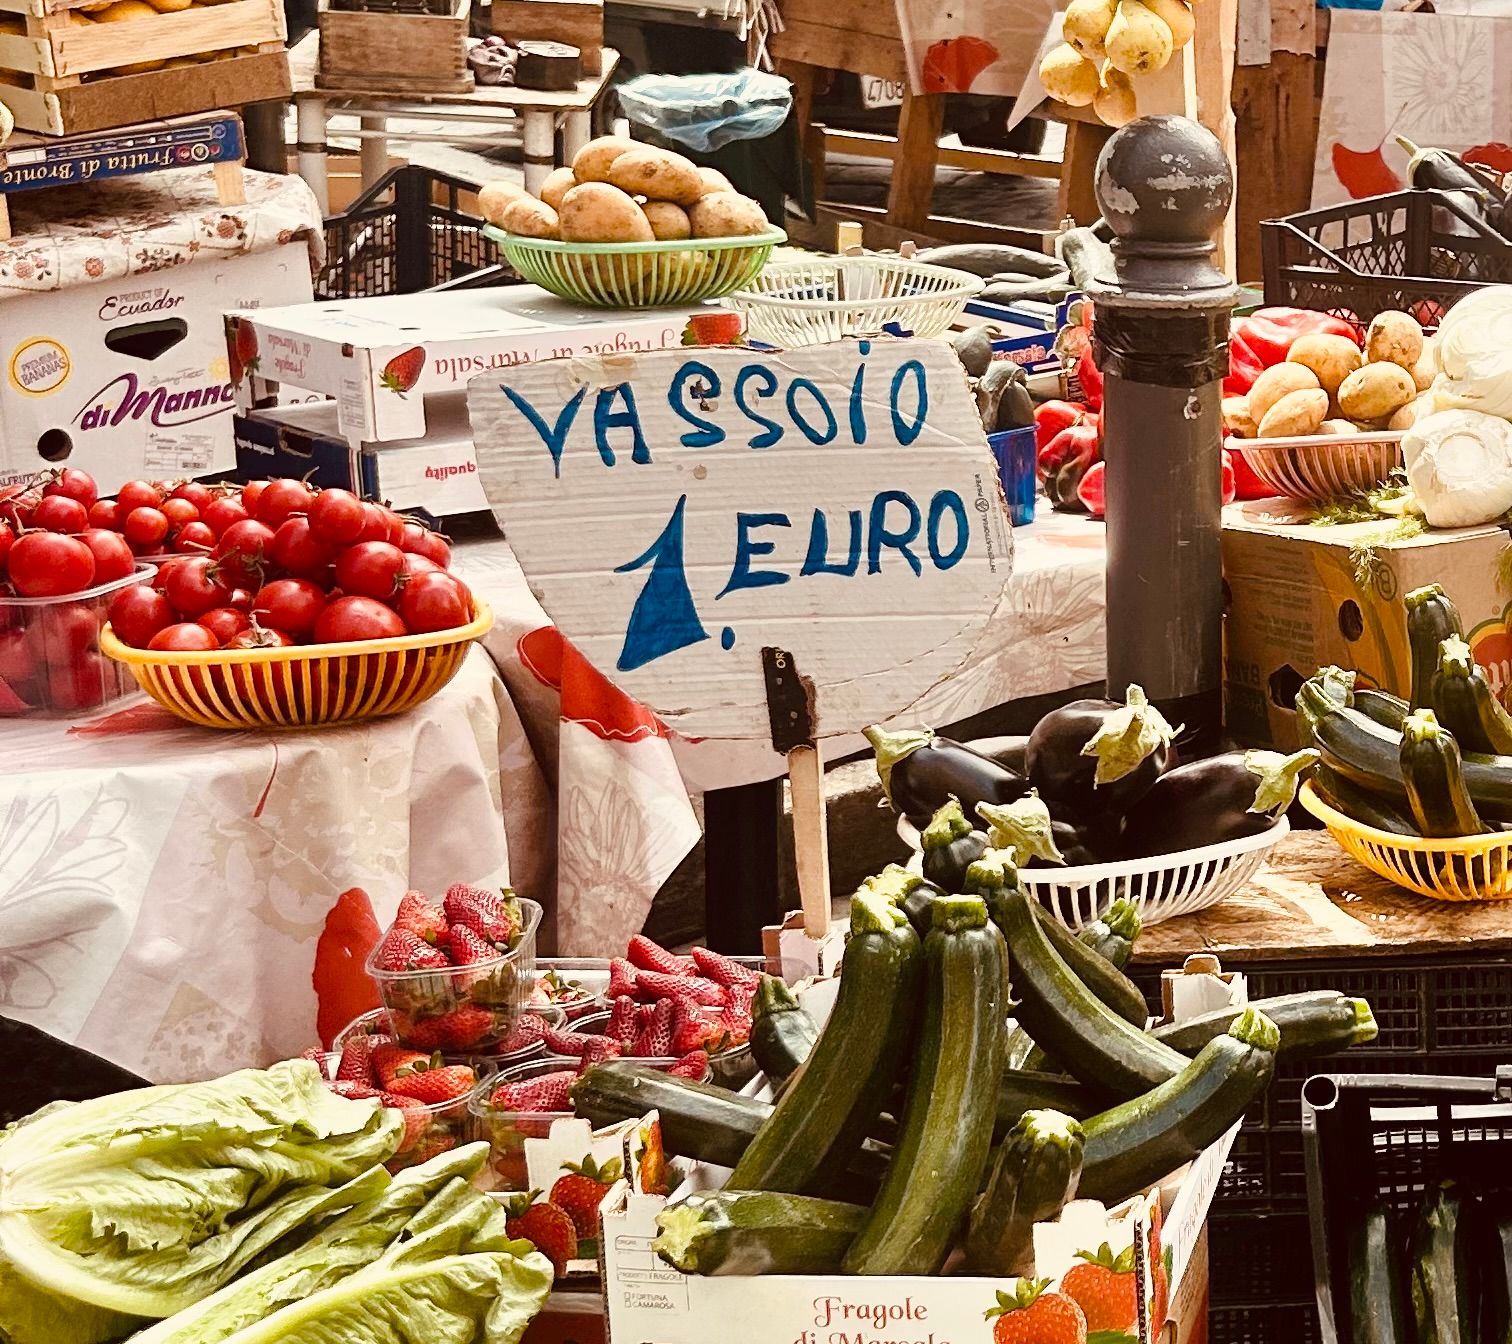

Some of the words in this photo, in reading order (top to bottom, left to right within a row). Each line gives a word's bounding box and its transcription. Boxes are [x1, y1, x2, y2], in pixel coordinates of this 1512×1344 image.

[80, 160, 100, 178] di
[108, 146, 175, 170] Frutta
[4, 163, 74, 185] Bronte
[99, 289, 185, 320] Ecuador
[21, 357, 67, 386] BANANAS
[499, 340, 930, 479] VASSOIO
[425, 462, 476, 480] quality
[715, 489, 971, 601] EURO
[632, 1302, 675, 1310] CAMAROSA
[812, 1296, 928, 1330] Fragole
